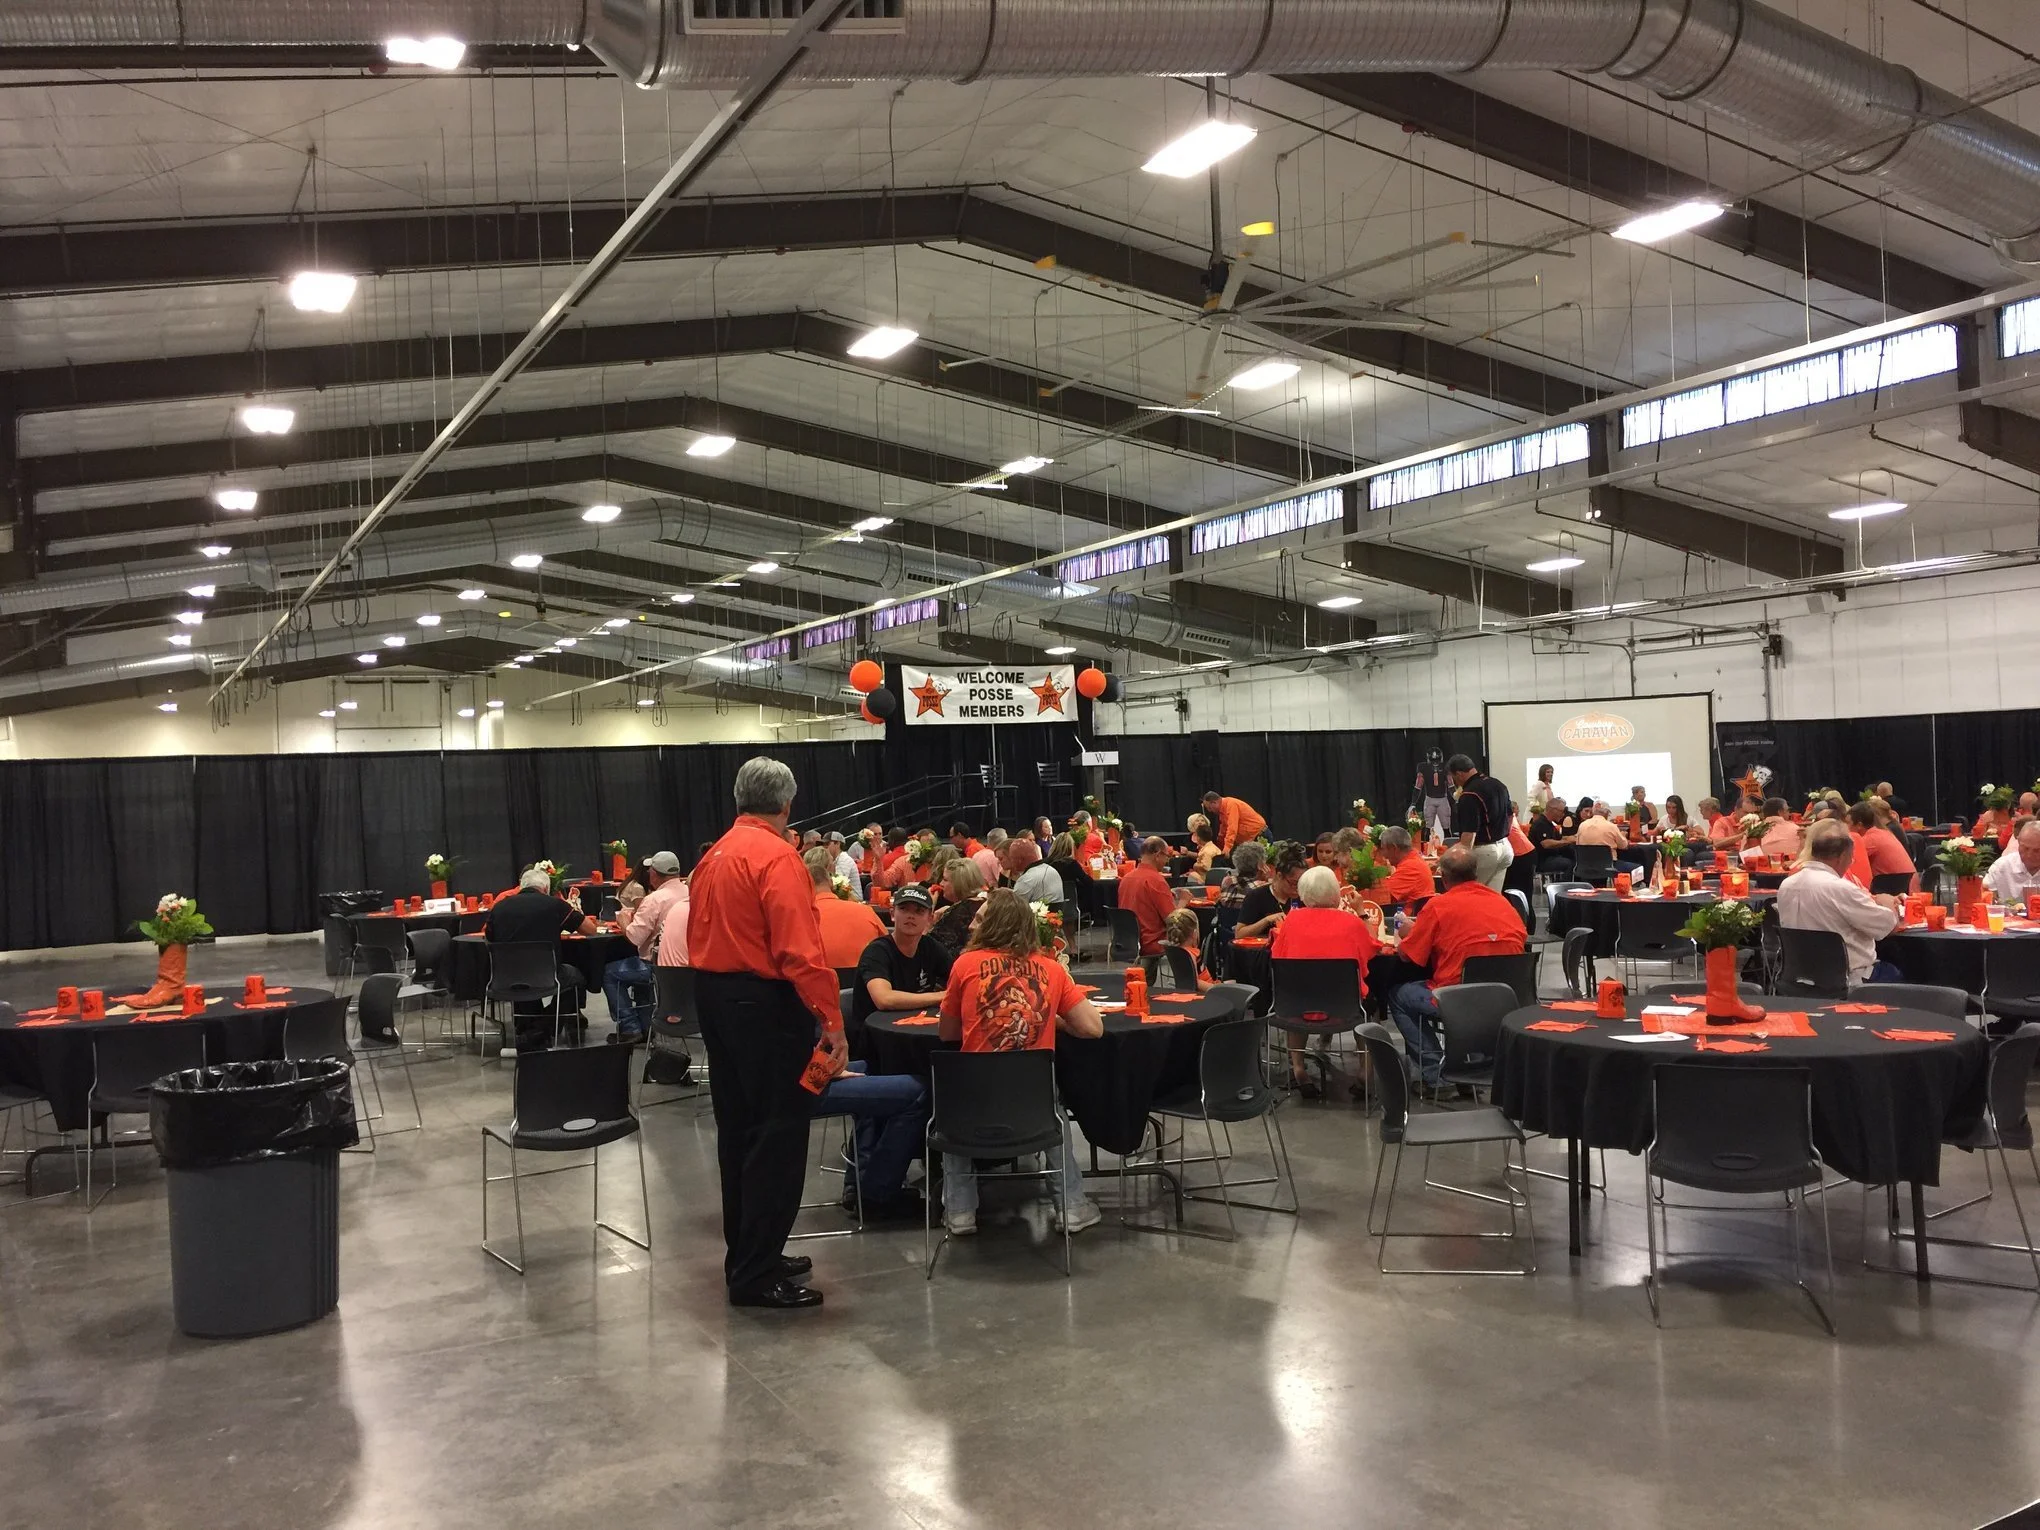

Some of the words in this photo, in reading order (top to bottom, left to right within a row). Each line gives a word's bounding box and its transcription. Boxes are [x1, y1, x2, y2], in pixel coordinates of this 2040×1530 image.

[957, 671, 1024, 684] WELCOME
[922, 695, 938, 707] POSSE
[969, 688, 1013, 701] POSSE
[959, 705, 1024, 717] MEMBERS
[1564, 726, 1629, 740] CARAVAN
[1095, 753, 1106, 763] W
[980, 957, 1049, 986] COWBOYS
